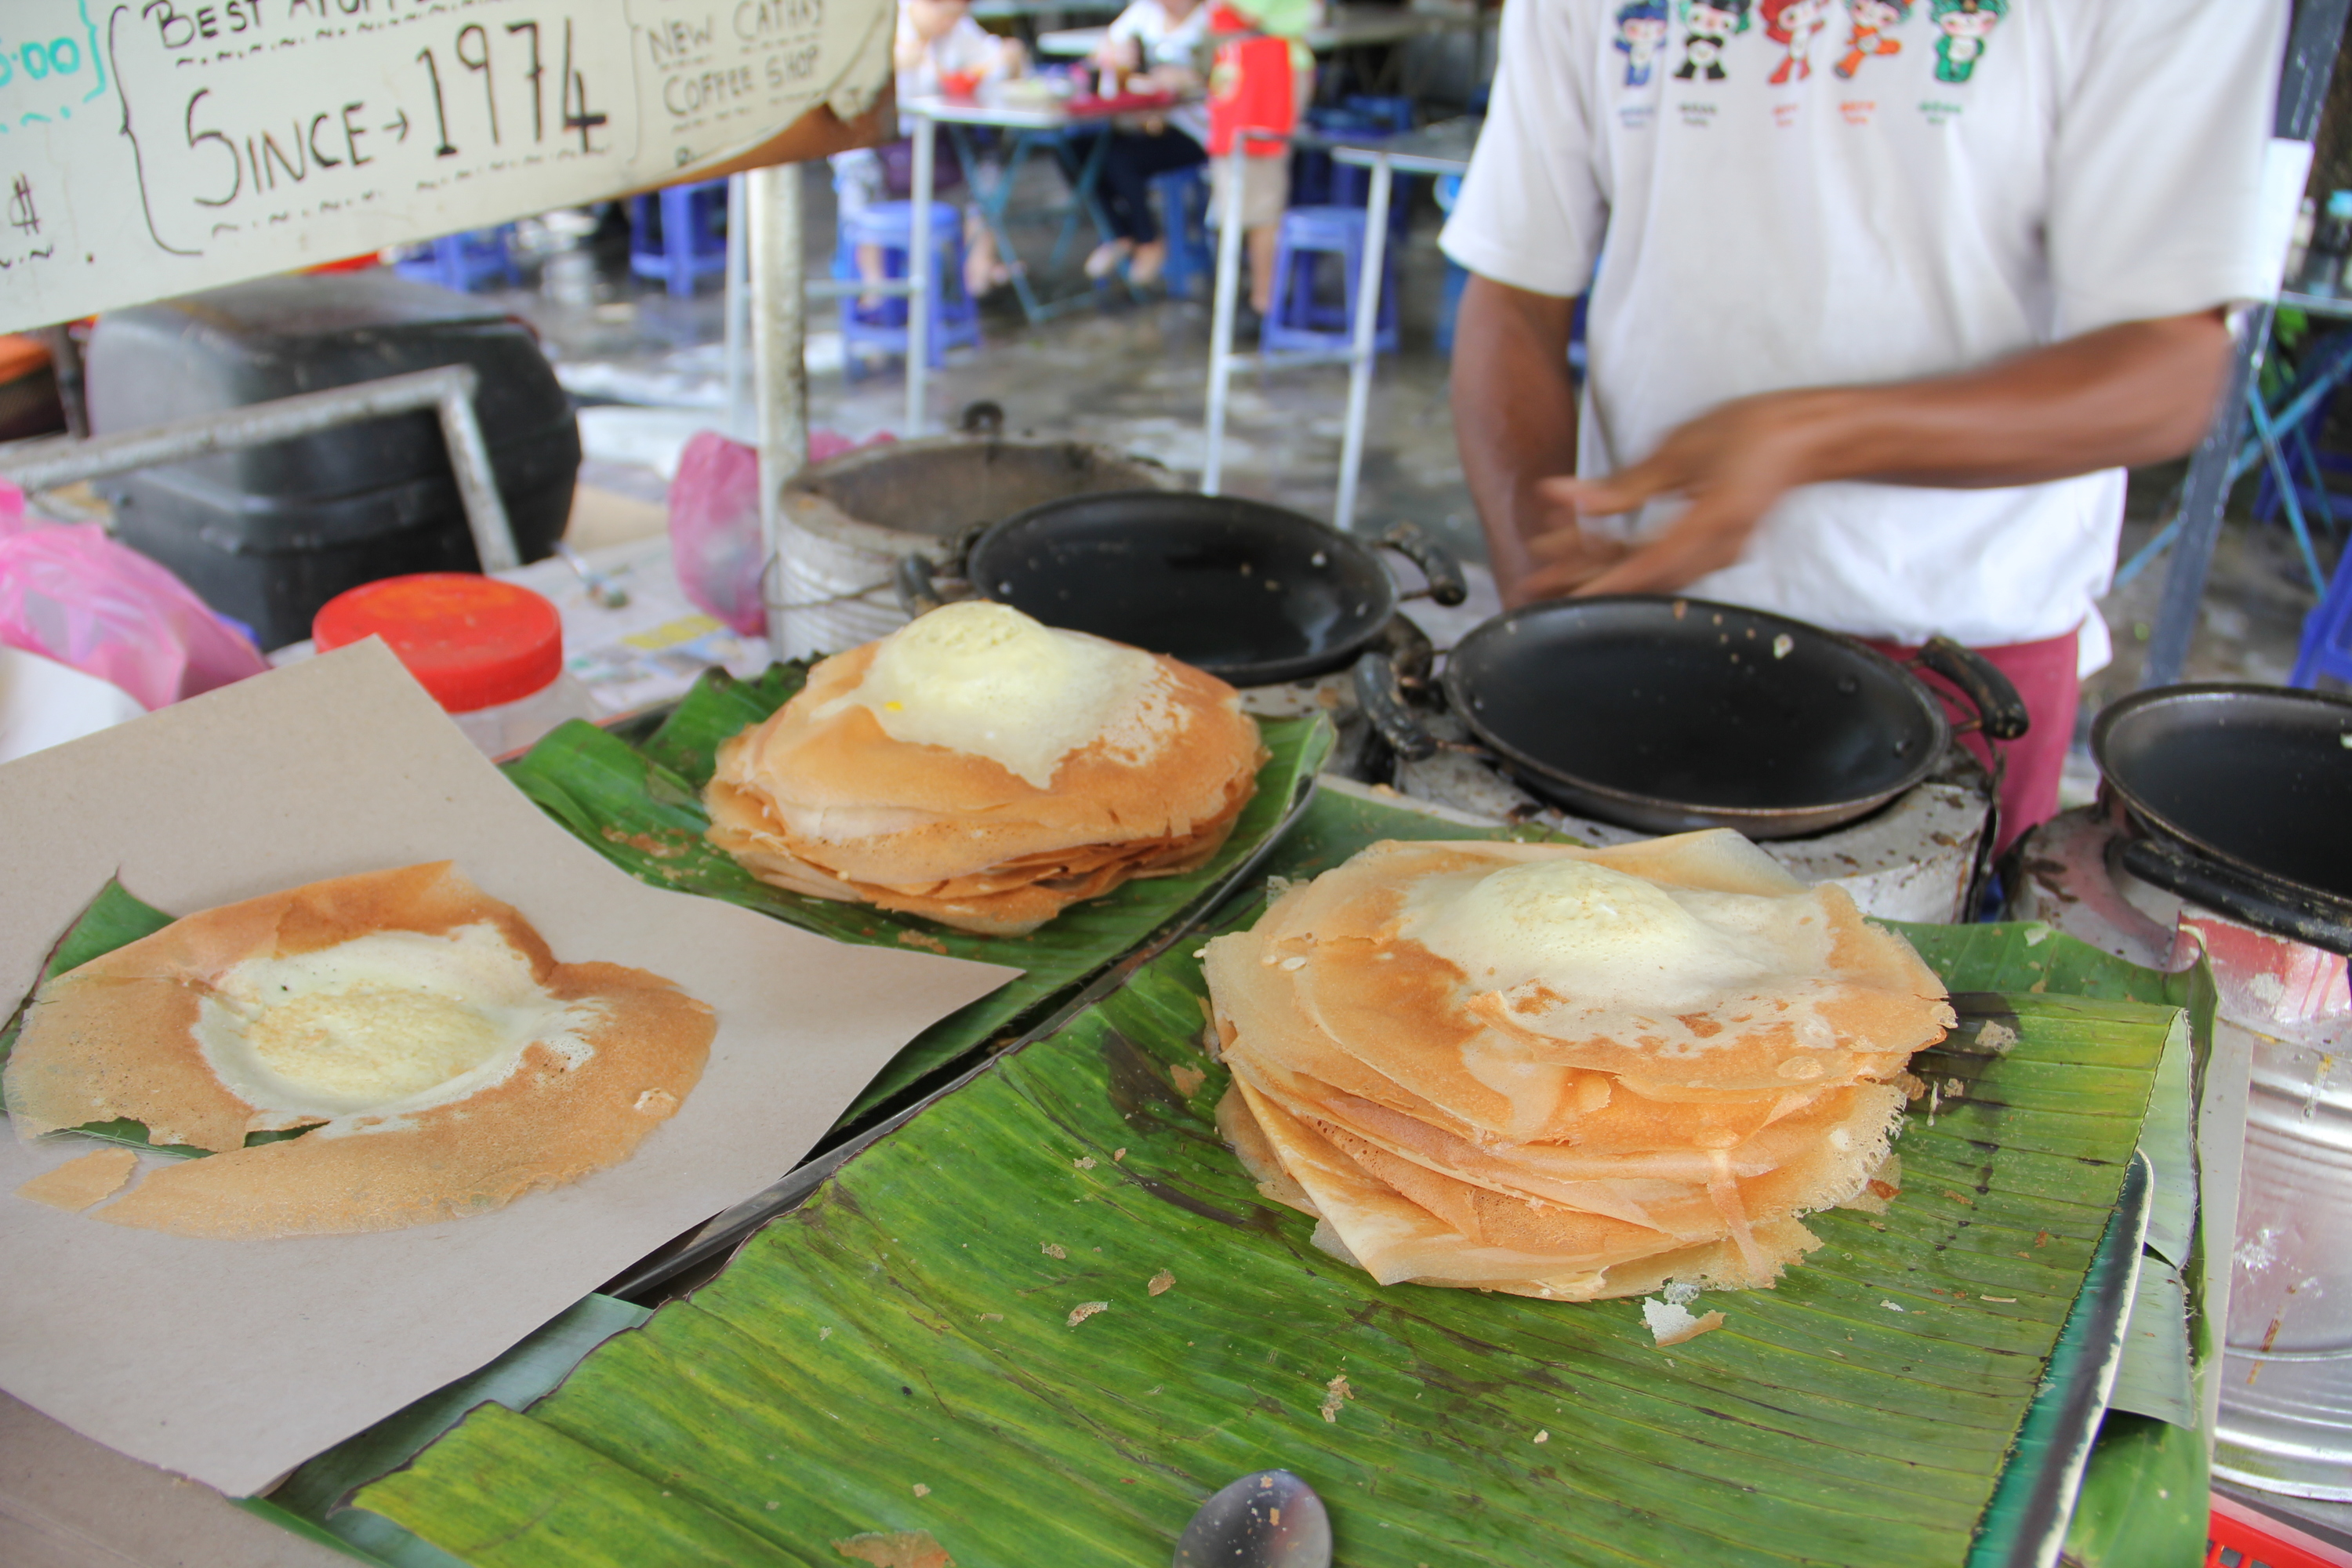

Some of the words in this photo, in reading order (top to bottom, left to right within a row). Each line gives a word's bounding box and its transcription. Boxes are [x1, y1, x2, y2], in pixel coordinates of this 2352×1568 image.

[141, 0, 260, 49] BEST
[647, 14, 713, 65] NEW
[663, 64, 753, 116] COFFEE
[765, 44, 818, 89] SHOP
[185, 88, 373, 206] SINCE
[416, 16, 608, 156] 1974
